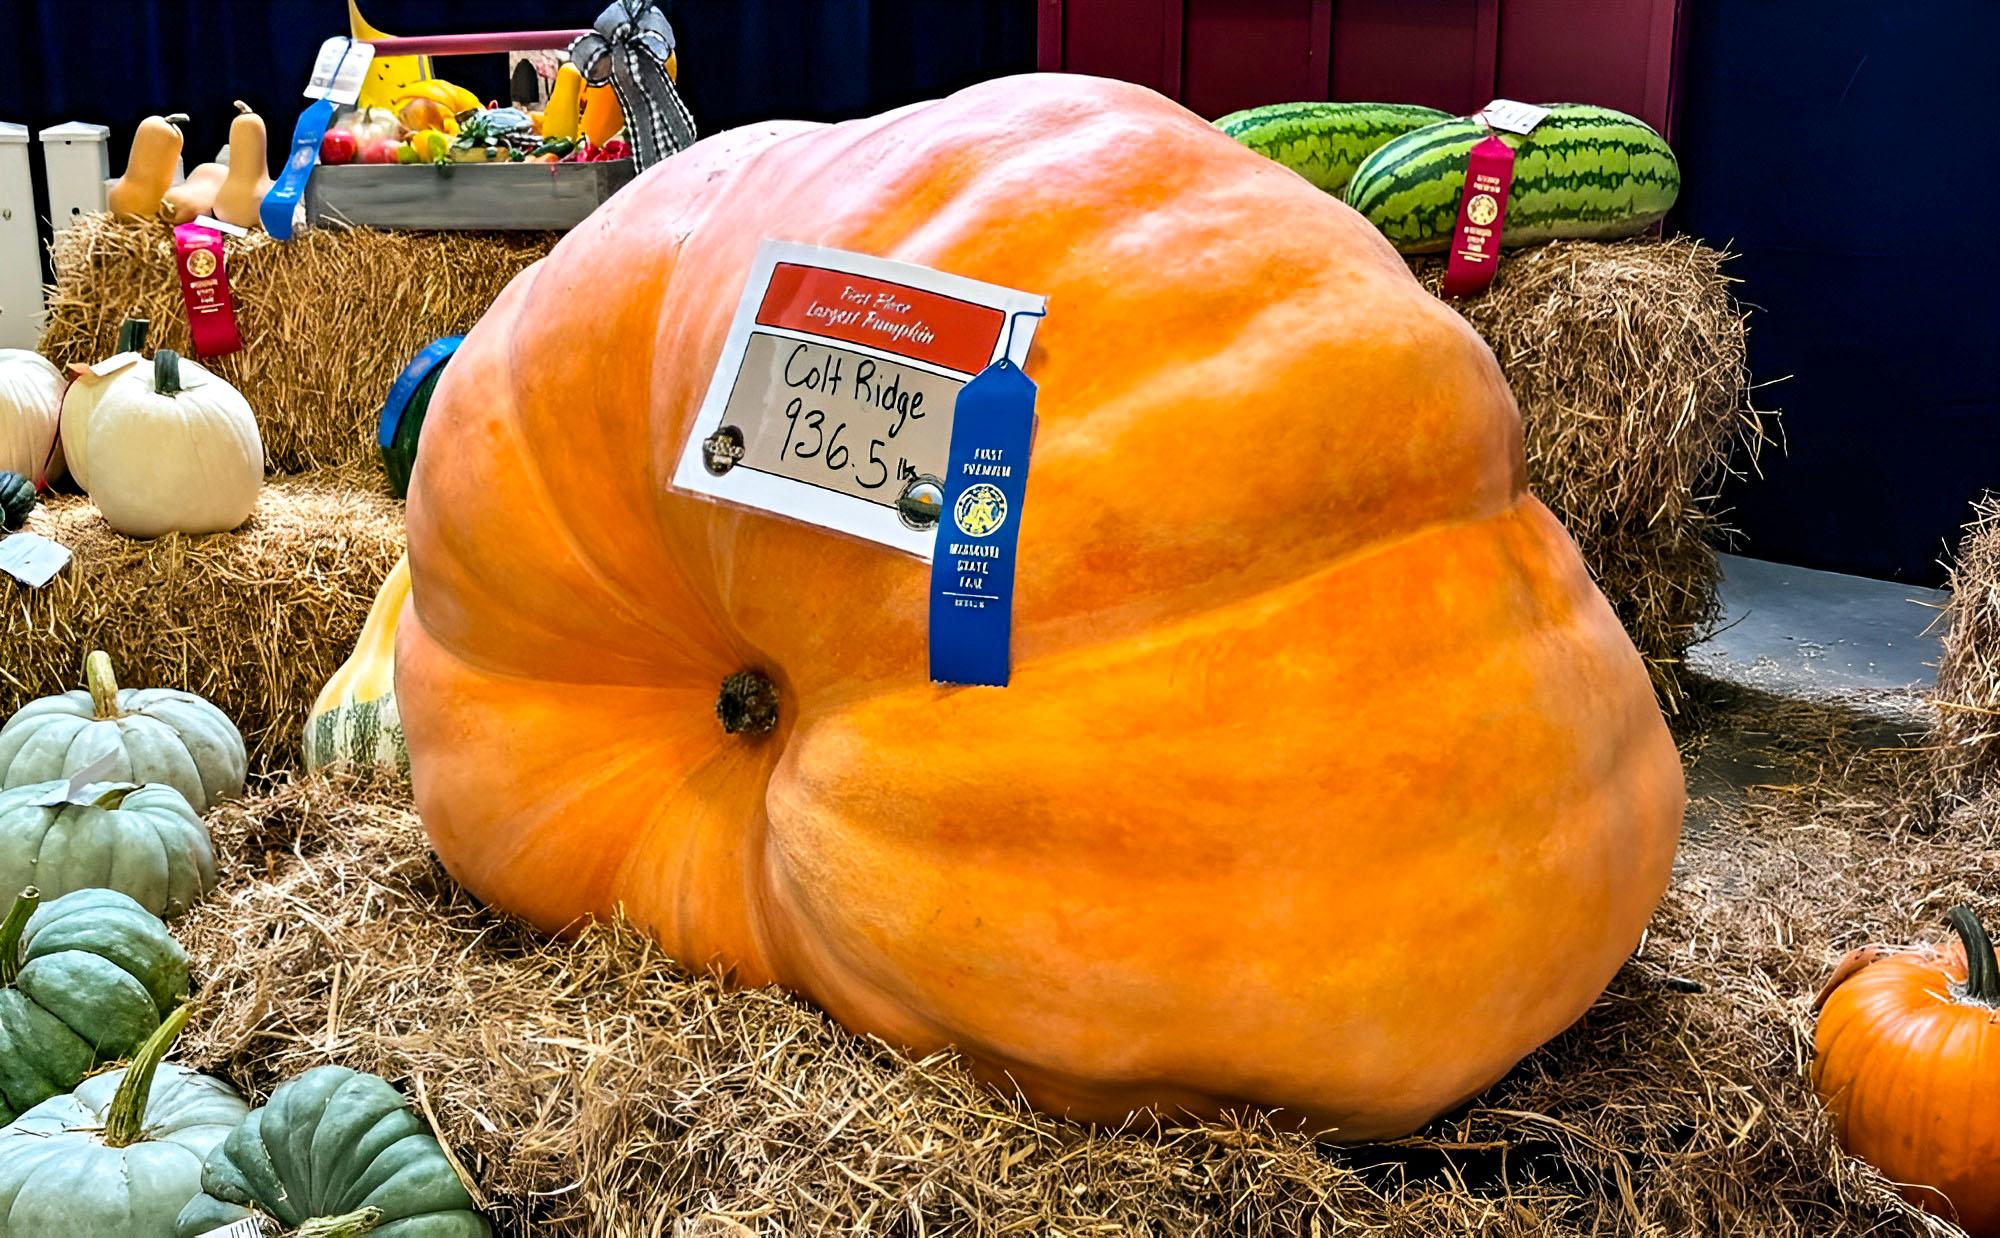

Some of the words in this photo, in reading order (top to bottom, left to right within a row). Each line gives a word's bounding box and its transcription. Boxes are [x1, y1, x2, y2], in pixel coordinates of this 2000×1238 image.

[806, 301, 861, 327] Largest
[861, 311, 935, 345] Pumpkin
[784, 344, 842, 396] Colt
[854, 359, 926, 438] Ridge
[780, 397, 888, 489] 936.5
